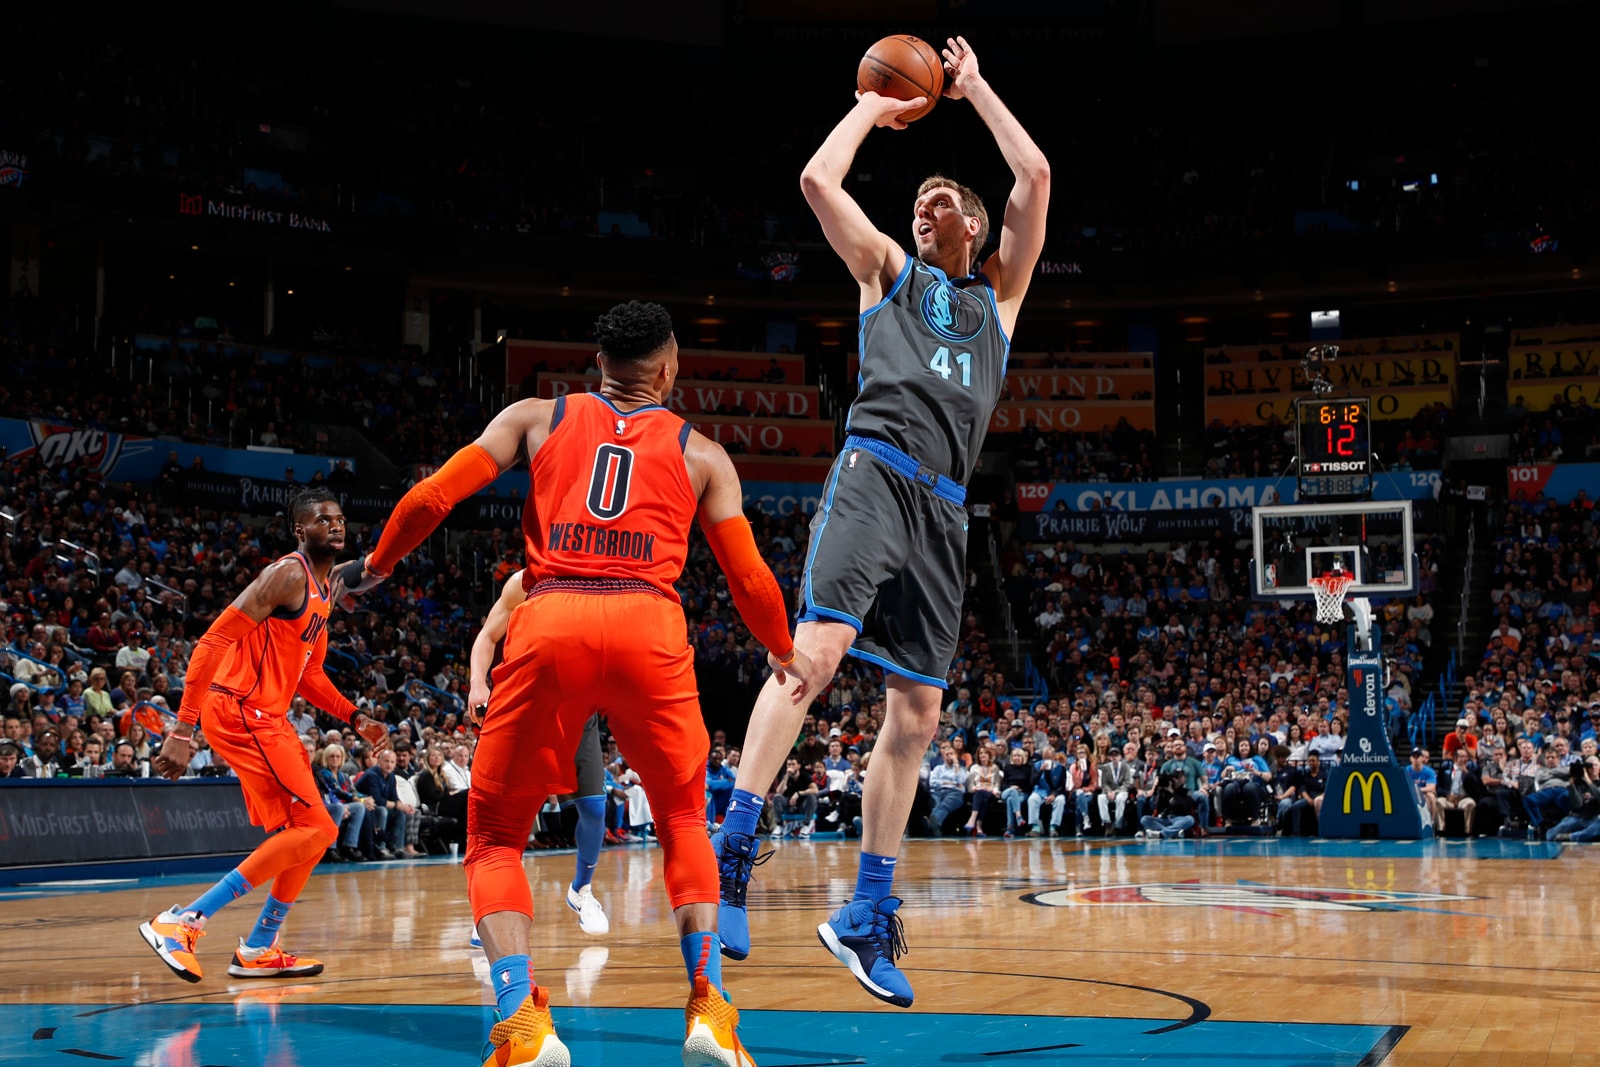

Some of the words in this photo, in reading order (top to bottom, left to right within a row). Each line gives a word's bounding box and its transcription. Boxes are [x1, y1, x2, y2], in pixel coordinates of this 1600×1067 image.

[930, 346, 972, 387] 41
[550, 380, 809, 417] RIRWIND
[1320, 405, 1360, 424] 6:12
[1327, 424, 1356, 456] 12
[1320, 461, 1366, 471] TISSOT
[1510, 467, 1539, 482] 101
[586, 443, 635, 521] 0
[1019, 485, 1049, 498] 120
[1076, 484, 1280, 512] OKLAHOMA
[1035, 512, 1100, 539] PRAIRIE
[1104, 512, 1147, 539] WOLF
[548, 523, 655, 563] WESTBROOK
[1364, 673, 1376, 717] devon
[1343, 753, 1390, 763] Medicine
